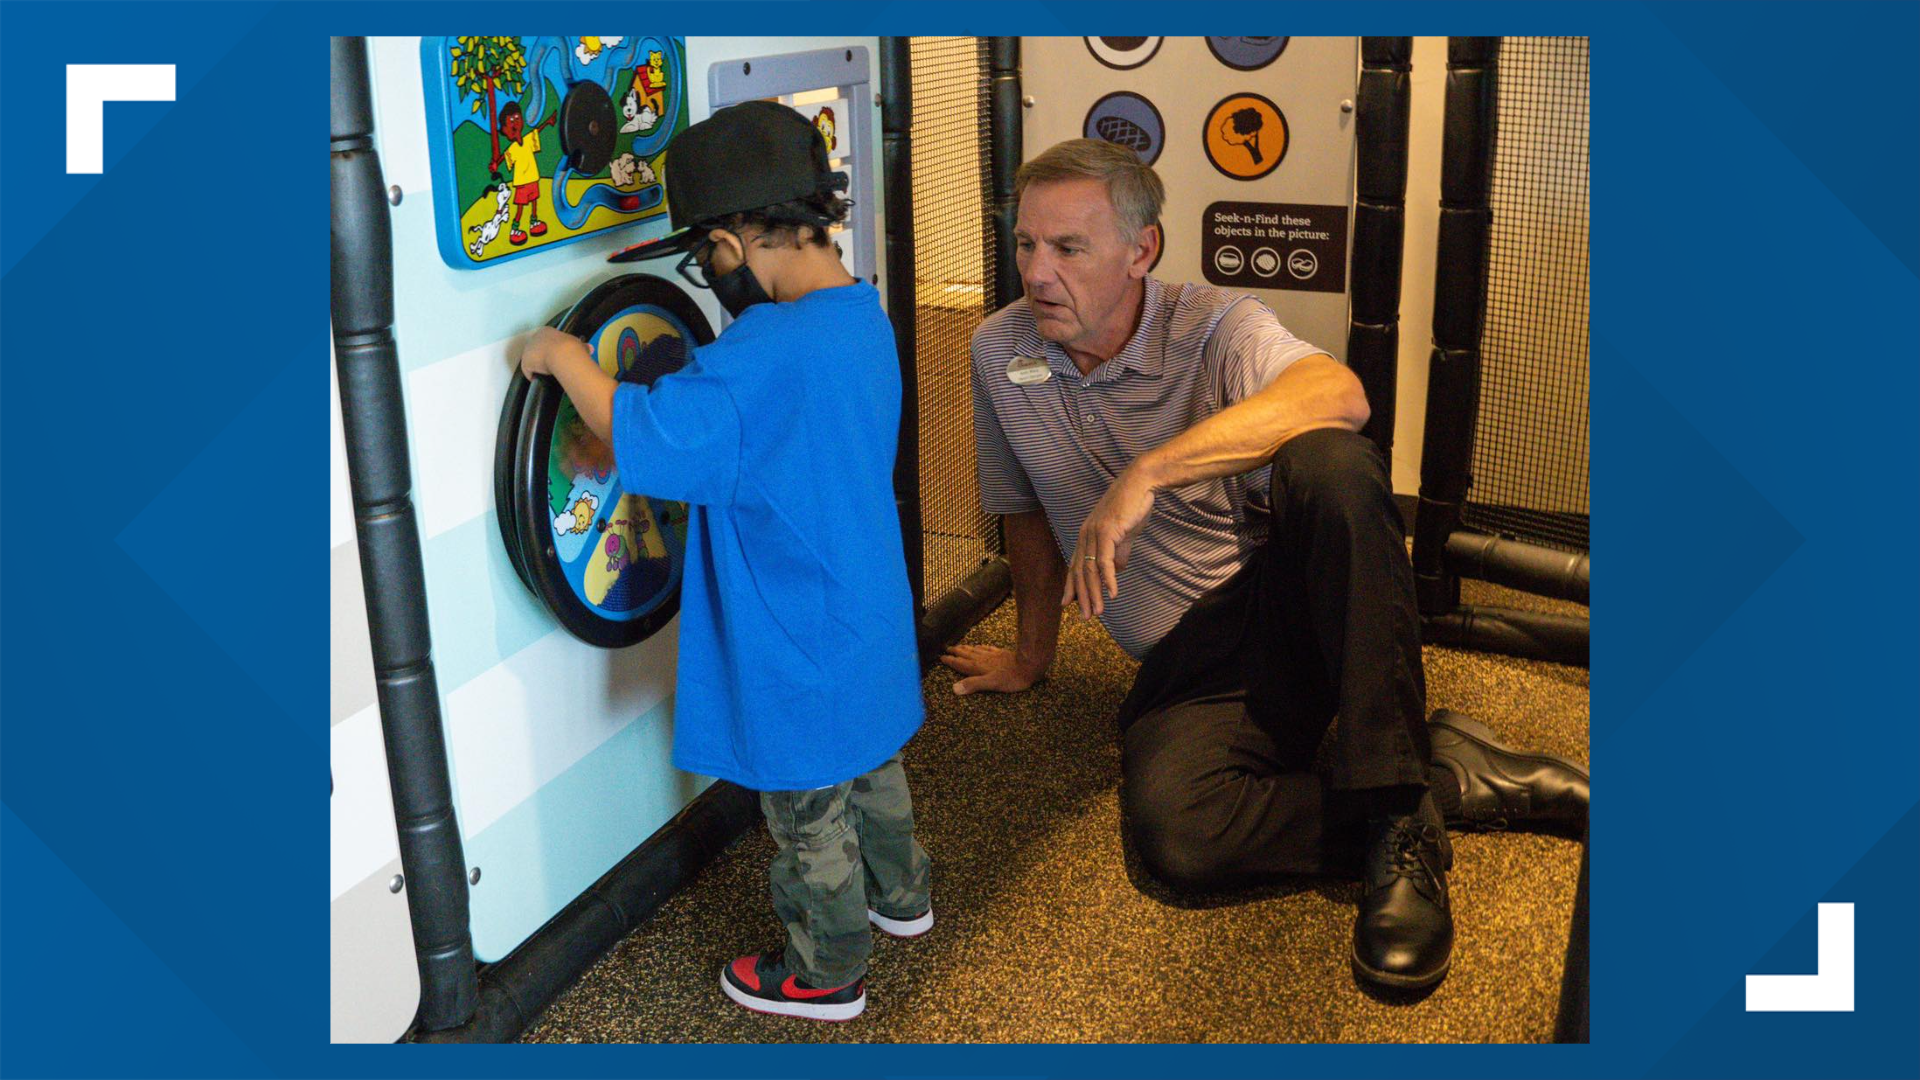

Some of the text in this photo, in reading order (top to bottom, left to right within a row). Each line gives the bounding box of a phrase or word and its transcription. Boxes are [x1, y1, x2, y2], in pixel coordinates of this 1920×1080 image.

[1214, 212, 1311, 227] Seek-n-Find these
[1214, 225, 1330, 241] objects in the picture:
